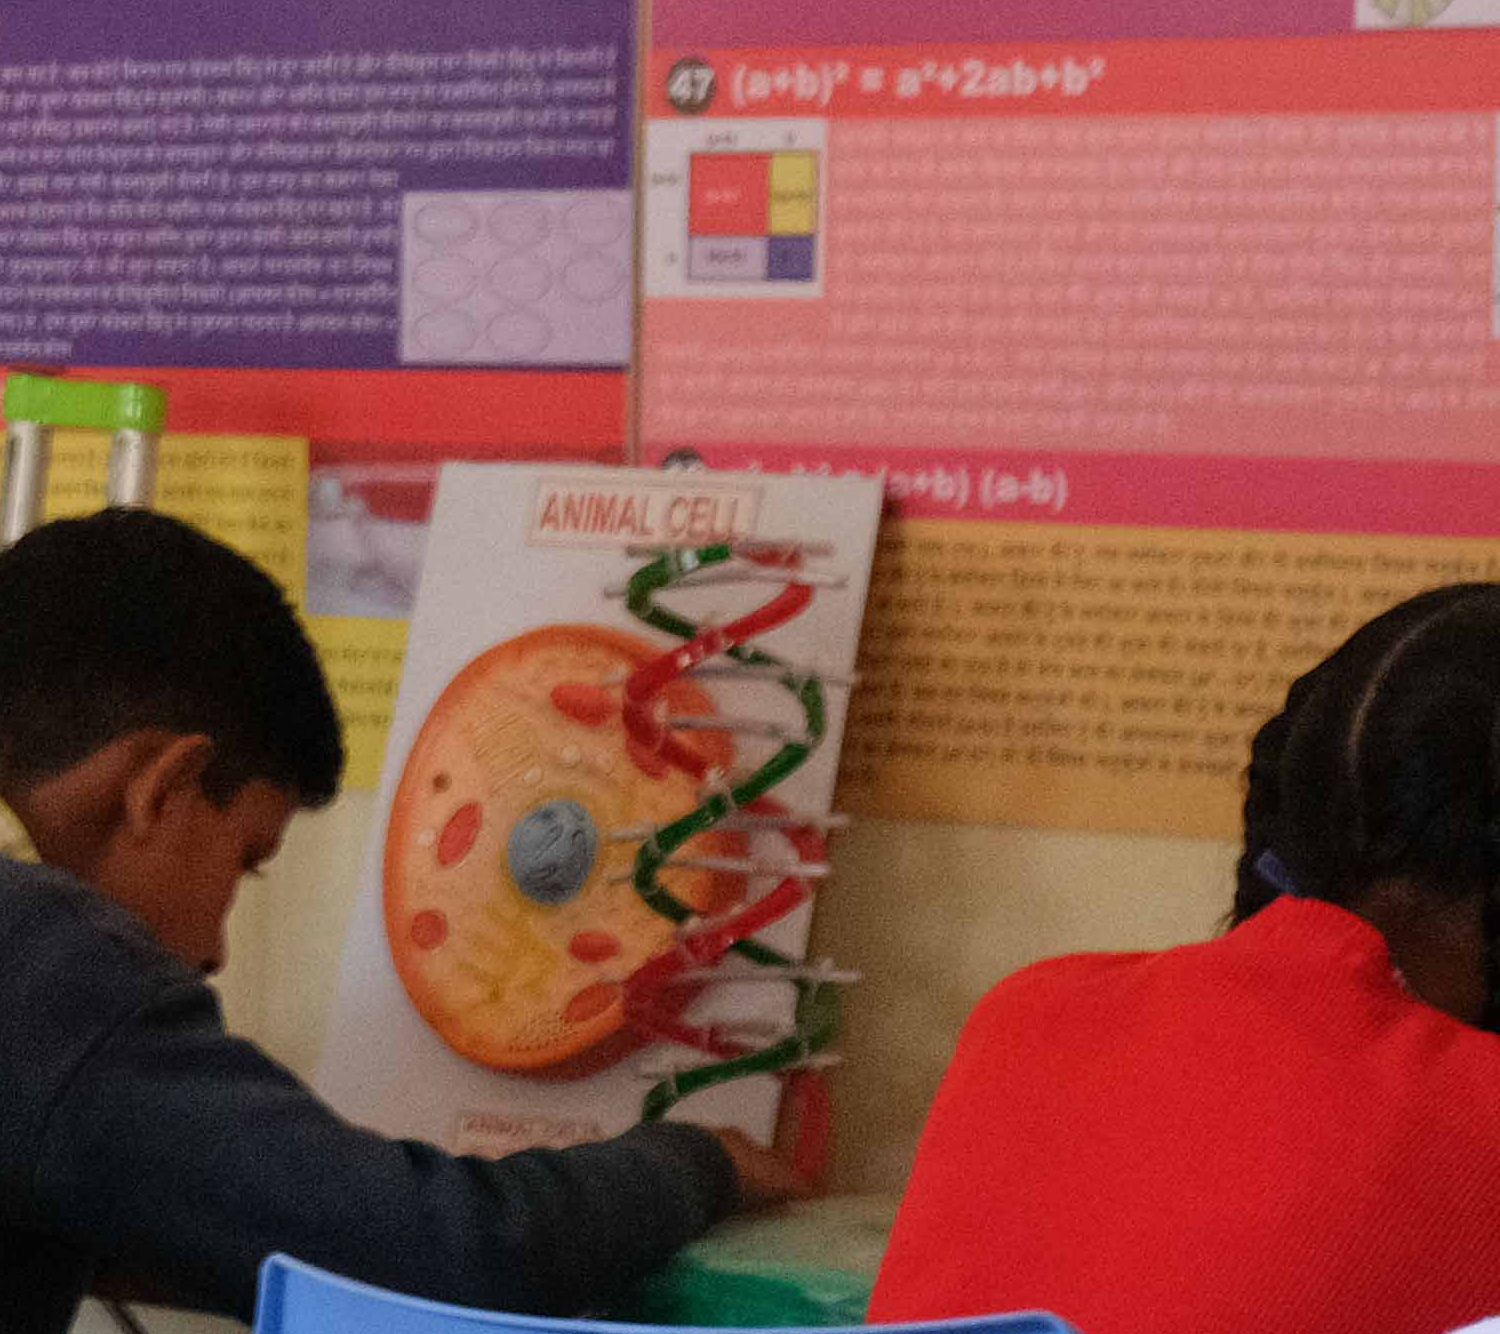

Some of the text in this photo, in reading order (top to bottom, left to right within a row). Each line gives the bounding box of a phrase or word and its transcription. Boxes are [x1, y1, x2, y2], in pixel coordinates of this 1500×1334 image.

[672, 74, 714, 102] 47
[540, 494, 746, 543] ANIMAL CELL
